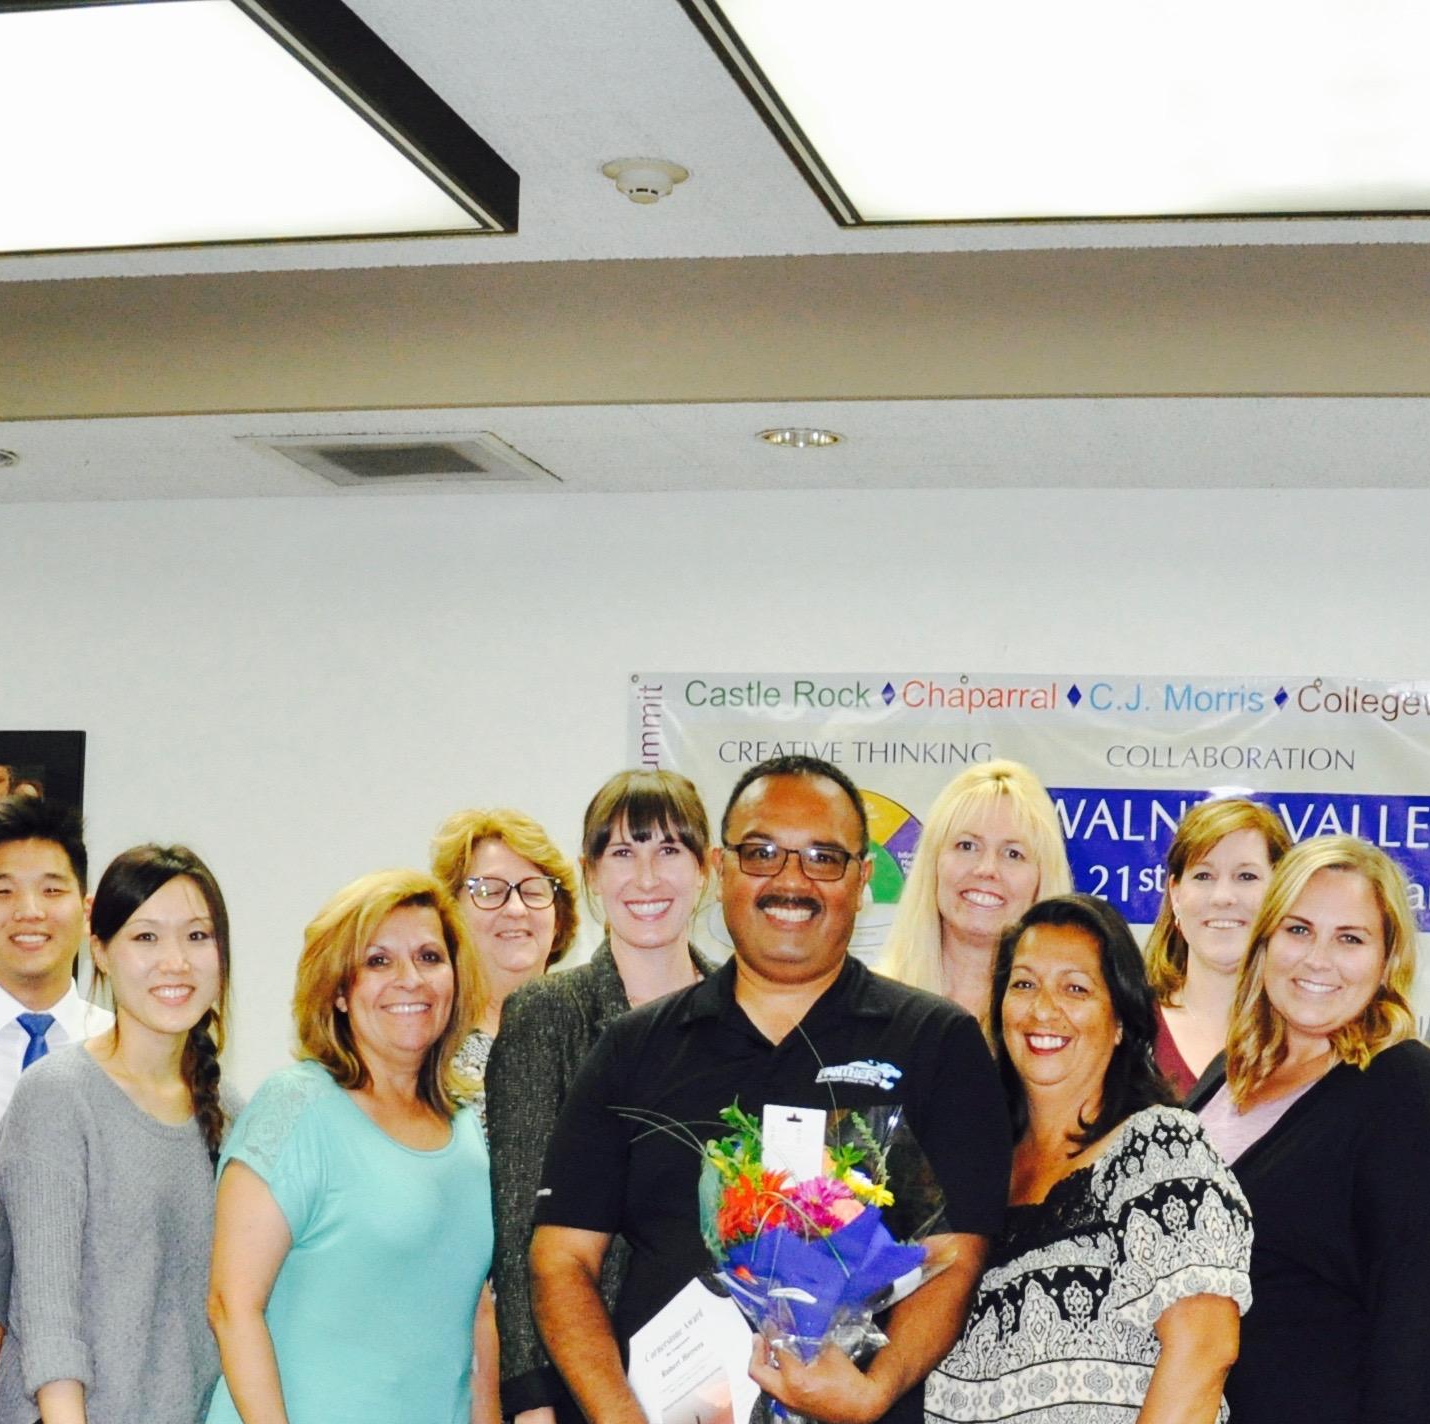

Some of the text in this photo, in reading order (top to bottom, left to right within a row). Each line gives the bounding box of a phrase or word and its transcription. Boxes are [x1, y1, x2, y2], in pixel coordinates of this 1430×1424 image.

[684, 680, 781, 708] Castle
[793, 680, 871, 709] Rock
[901, 679, 1057, 714] Chaparral
[1089, 683, 1150, 712] C.J.
[1164, 684, 1265, 714] Morris
[718, 740, 992, 765] CREATIVE THINKING
[1105, 745, 1355, 771] COLLABORATION
[1088, 863, 1166, 903] 21st
